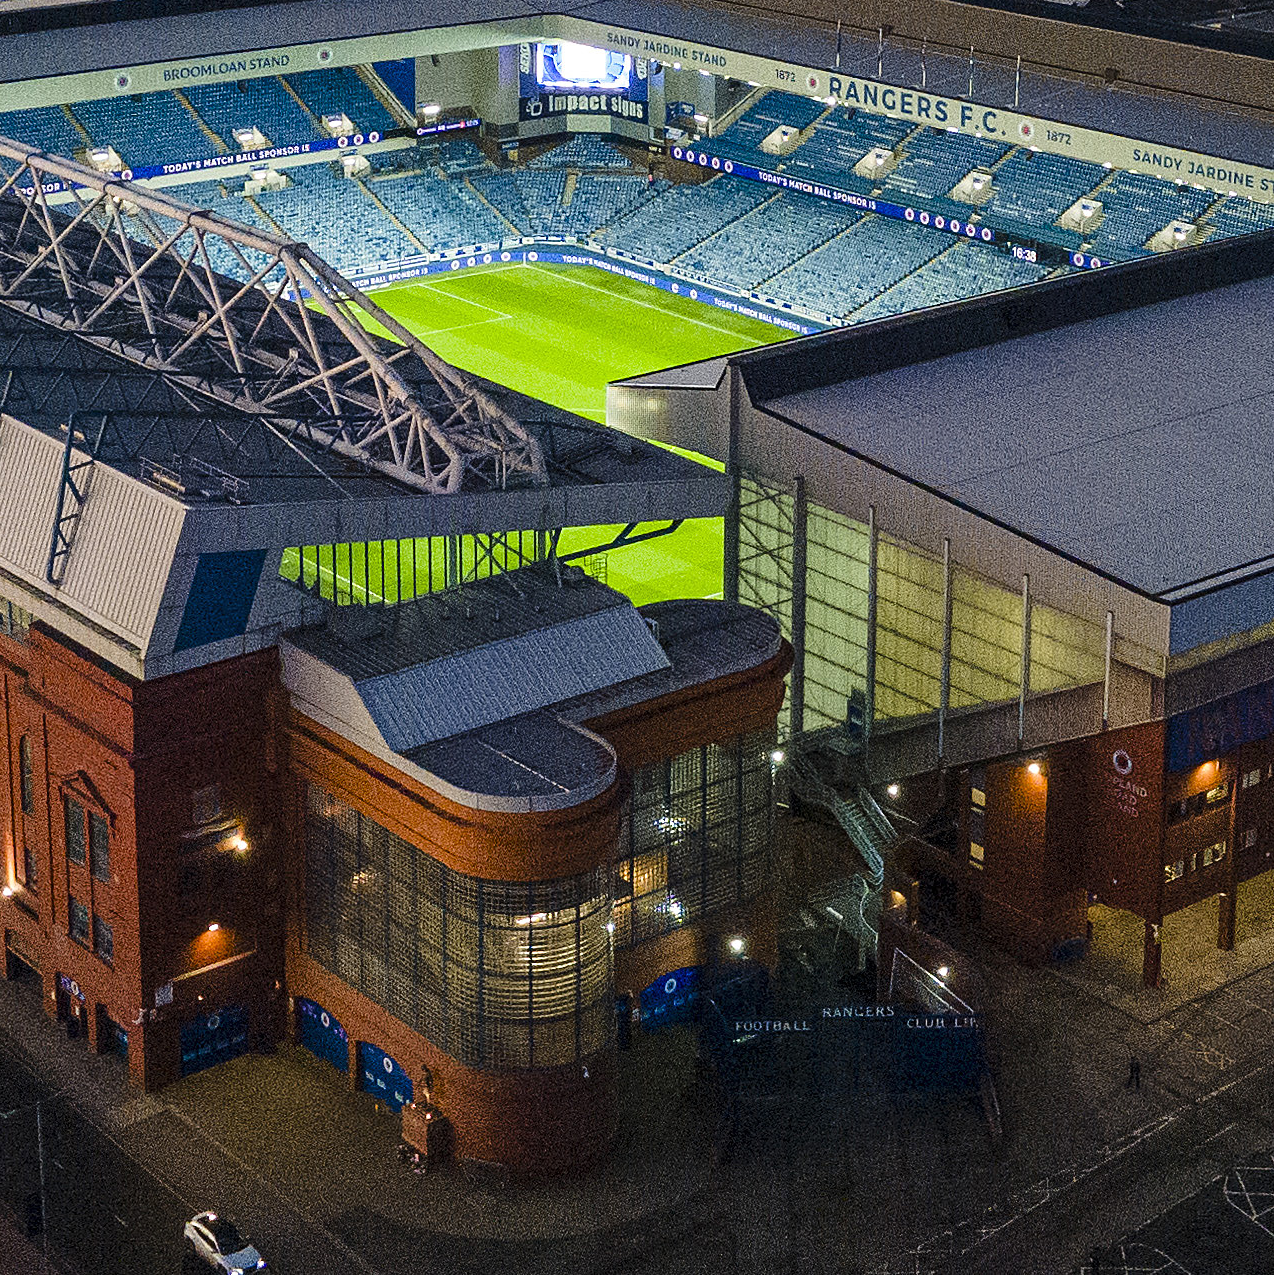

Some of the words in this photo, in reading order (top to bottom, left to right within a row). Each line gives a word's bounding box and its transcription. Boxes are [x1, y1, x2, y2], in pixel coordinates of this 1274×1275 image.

[607, 33, 641, 49] SANDY
[643, 40, 688, 59] JARDINE
[691, 50, 727, 67] STAND
[163, 61, 247, 81] BROOMLOAN
[249, 55, 290, 70] STAND
[611, 96, 643, 119] signs
[775, 69, 796, 83] 1872
[829, 77, 949, 123] RANGERS
[960, 106, 1006, 136] F.C.
[1046, 130, 1071, 146] 1872
[163, 161, 201, 174] TODAY'S
[203, 156, 234, 169] MATCH
[236, 151, 258, 163] BALL
[259, 146, 300, 160] SPONSOR
[1133, 149, 1183, 171] SANDY
[1188, 162, 1254, 188] JARDINE
[758, 171, 787, 186] TODAY'S
[788, 179, 812, 193] MATCH
[814, 186, 831, 198] BALL
[833, 191, 867, 208] SPONSOR
[1012, 246, 1037, 263] 16:38
[371, 275, 387, 285] BALL
[735, 1020, 811, 1031] FOOTBALL
[906, 1018, 945, 1029] CLUB
[822, 1006, 895, 1017] RANGERS
